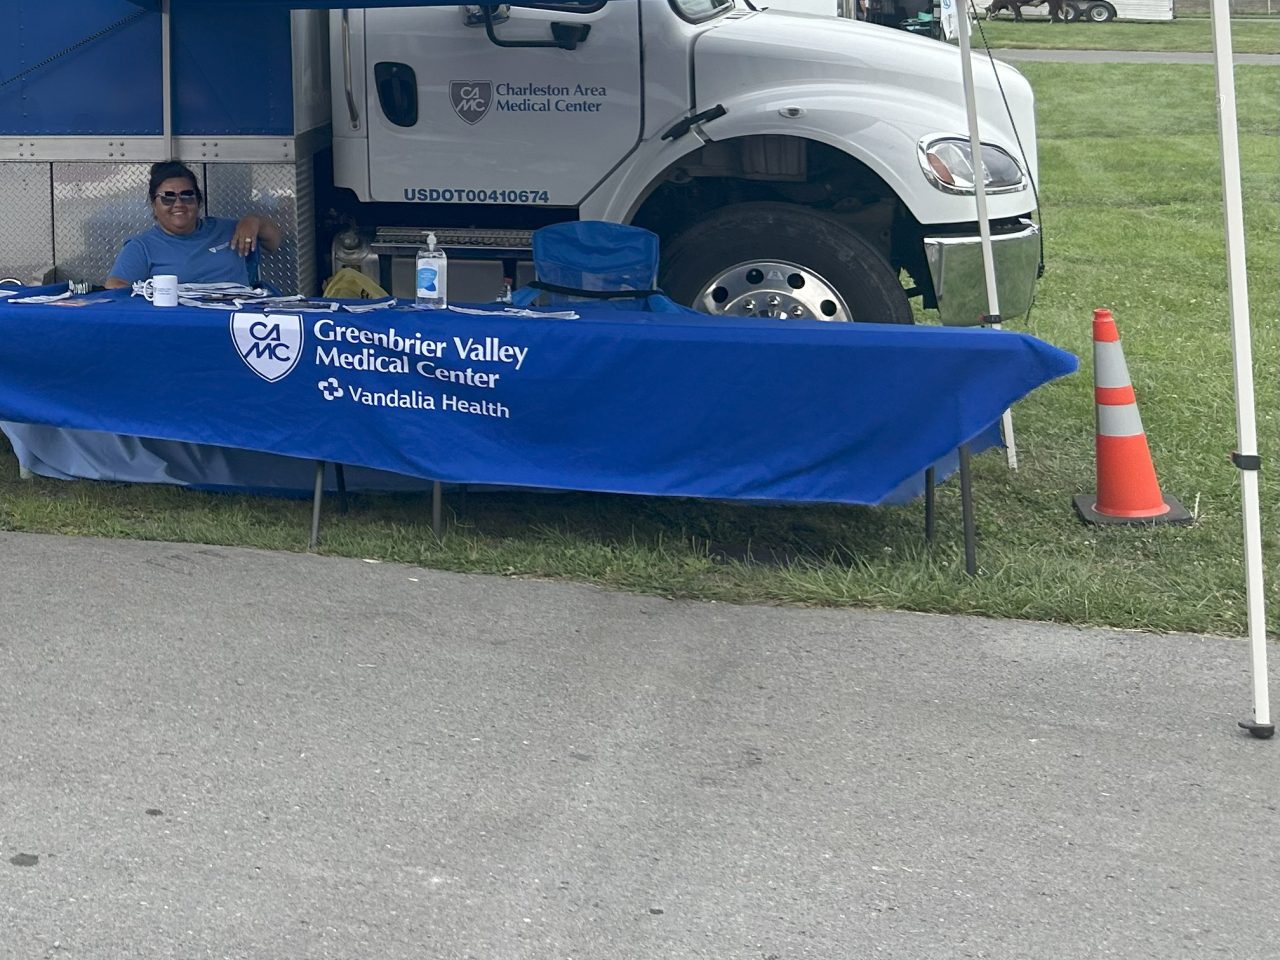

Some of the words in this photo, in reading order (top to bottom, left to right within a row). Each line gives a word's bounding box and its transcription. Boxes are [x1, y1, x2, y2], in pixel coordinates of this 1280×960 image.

[496, 83, 569, 96] Charleston
[573, 84, 607, 96] Area
[496, 99, 550, 112] Medical
[555, 100, 602, 112] Center
[404, 188, 549, 203] USDOT00410674
[313, 319, 447, 358] Greenbrier
[453, 336, 528, 370] Valley
[315, 346, 409, 374] Medical
[416, 361, 500, 389] Center
[348, 385, 436, 410] Vandalia
[442, 394, 510, 419] Health
